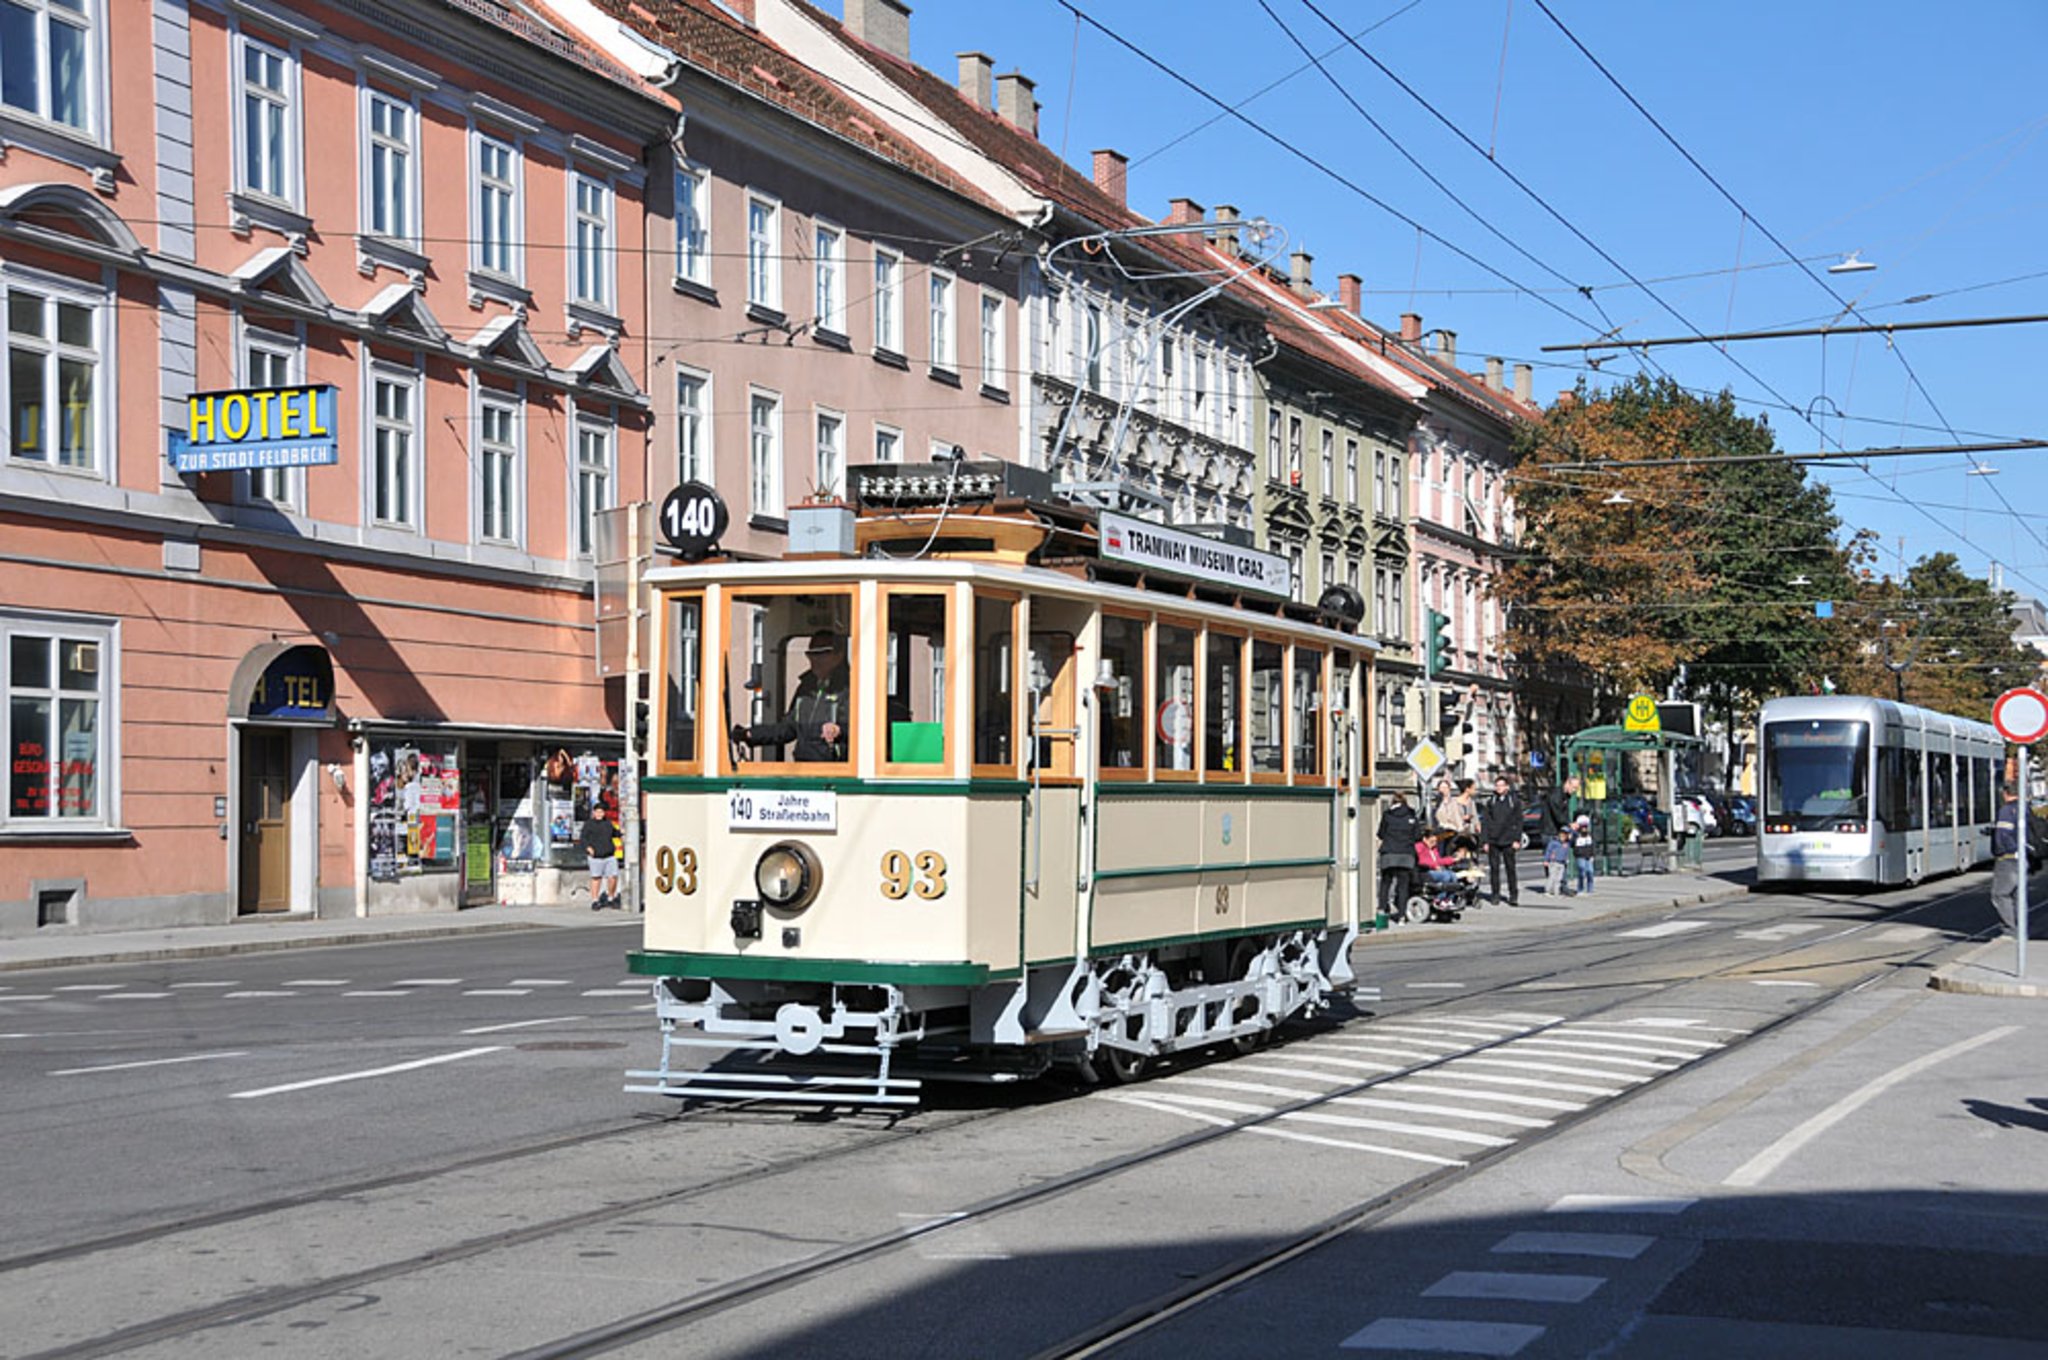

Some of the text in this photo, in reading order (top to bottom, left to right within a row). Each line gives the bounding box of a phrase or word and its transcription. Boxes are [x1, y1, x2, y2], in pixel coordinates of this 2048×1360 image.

[190, 389, 327, 442] HOTEL
[180, 446, 327, 470] ZUR STADT FELDBACH
[666, 497, 716, 537] 140
[1128, 530, 1188, 562] TRAMWAY
[1189, 545, 1236, 574] MUSEUM
[1236, 557, 1264, 580] GRAZ
[730, 797, 753, 820] 140
[759, 807, 831, 822] Straßenbahn
[777, 794, 809, 807] Jahre
[655, 845, 698, 895] 93
[880, 849, 948, 900] 93
